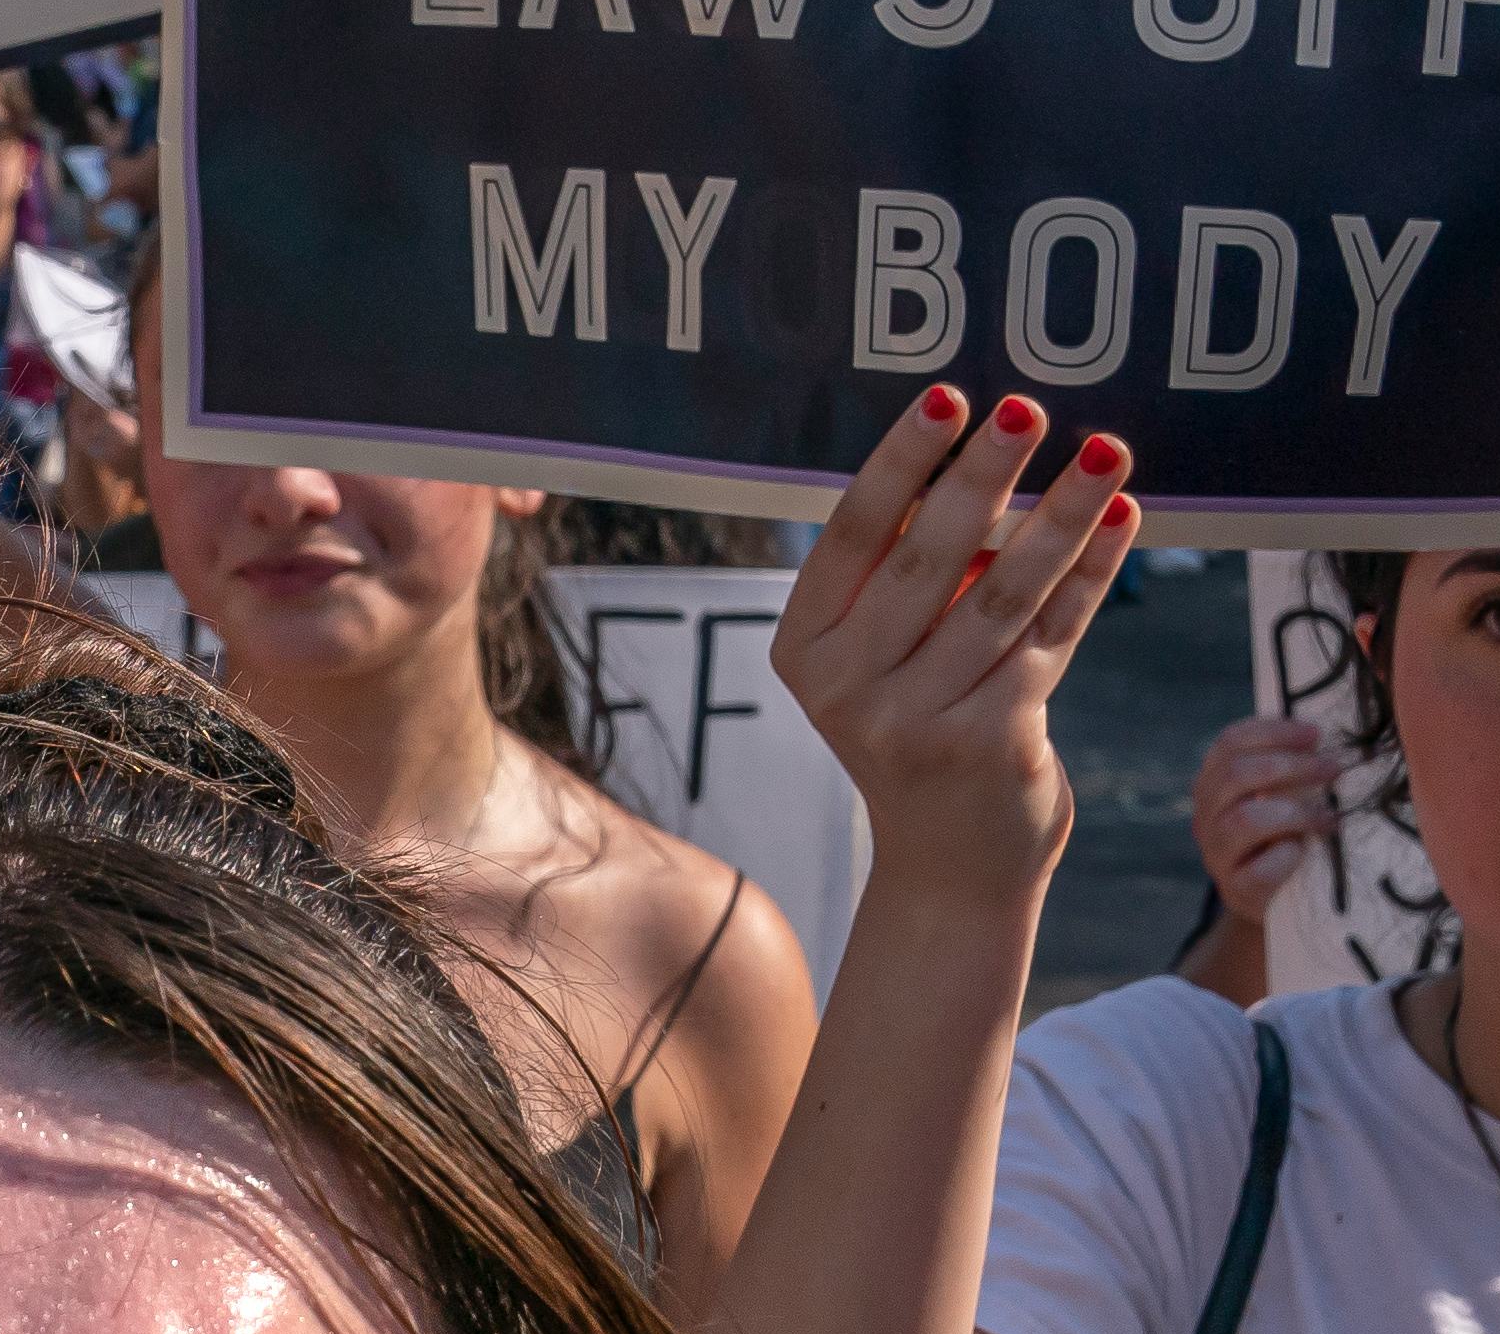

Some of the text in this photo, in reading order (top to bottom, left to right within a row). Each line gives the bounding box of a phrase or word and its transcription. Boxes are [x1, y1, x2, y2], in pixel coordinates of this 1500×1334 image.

[468, 161, 1442, 398] MY BODY
[590, 609, 779, 805] FF
